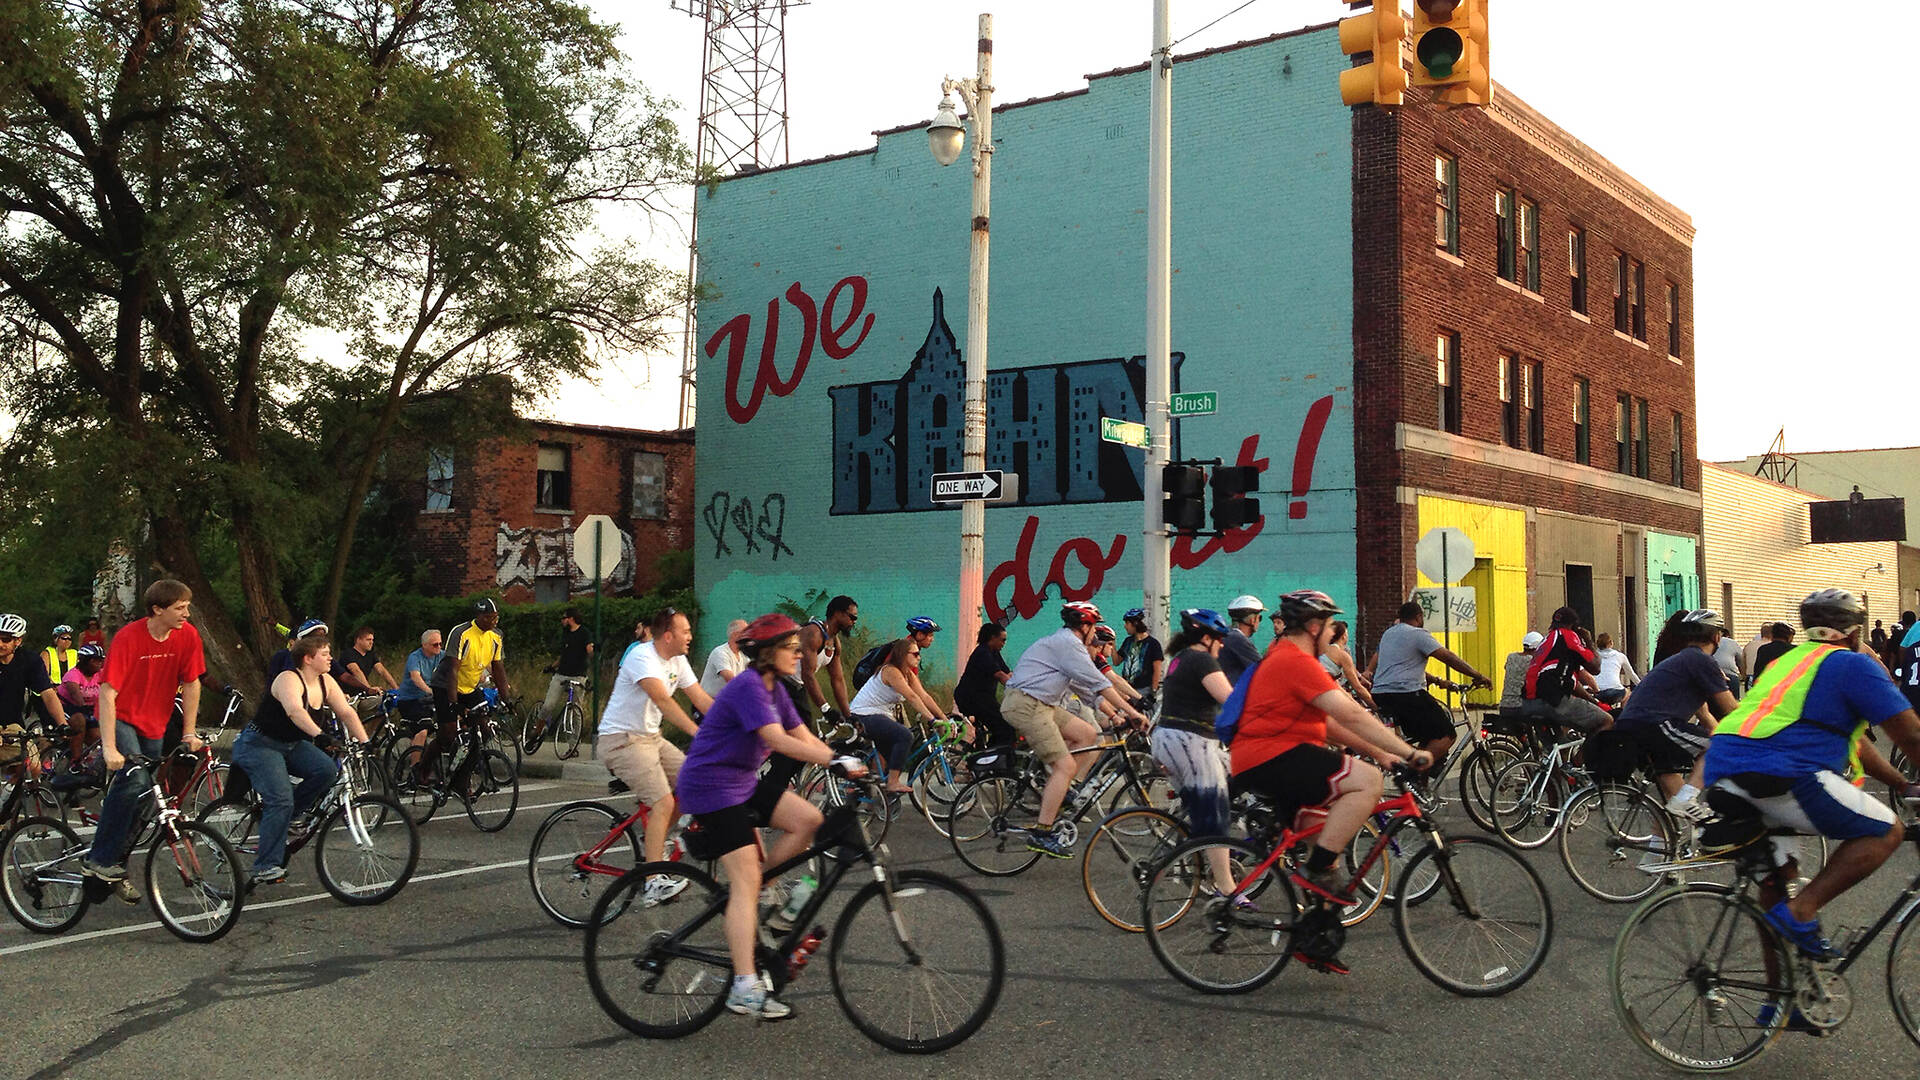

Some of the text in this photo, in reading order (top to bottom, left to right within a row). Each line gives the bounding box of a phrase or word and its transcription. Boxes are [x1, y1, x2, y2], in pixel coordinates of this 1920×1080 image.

[828, 286, 1185, 516] KAHN
[1175, 396, 1212, 412] Brush
[938, 480, 986, 493] ONE WAY
[983, 515, 1127, 623] do
